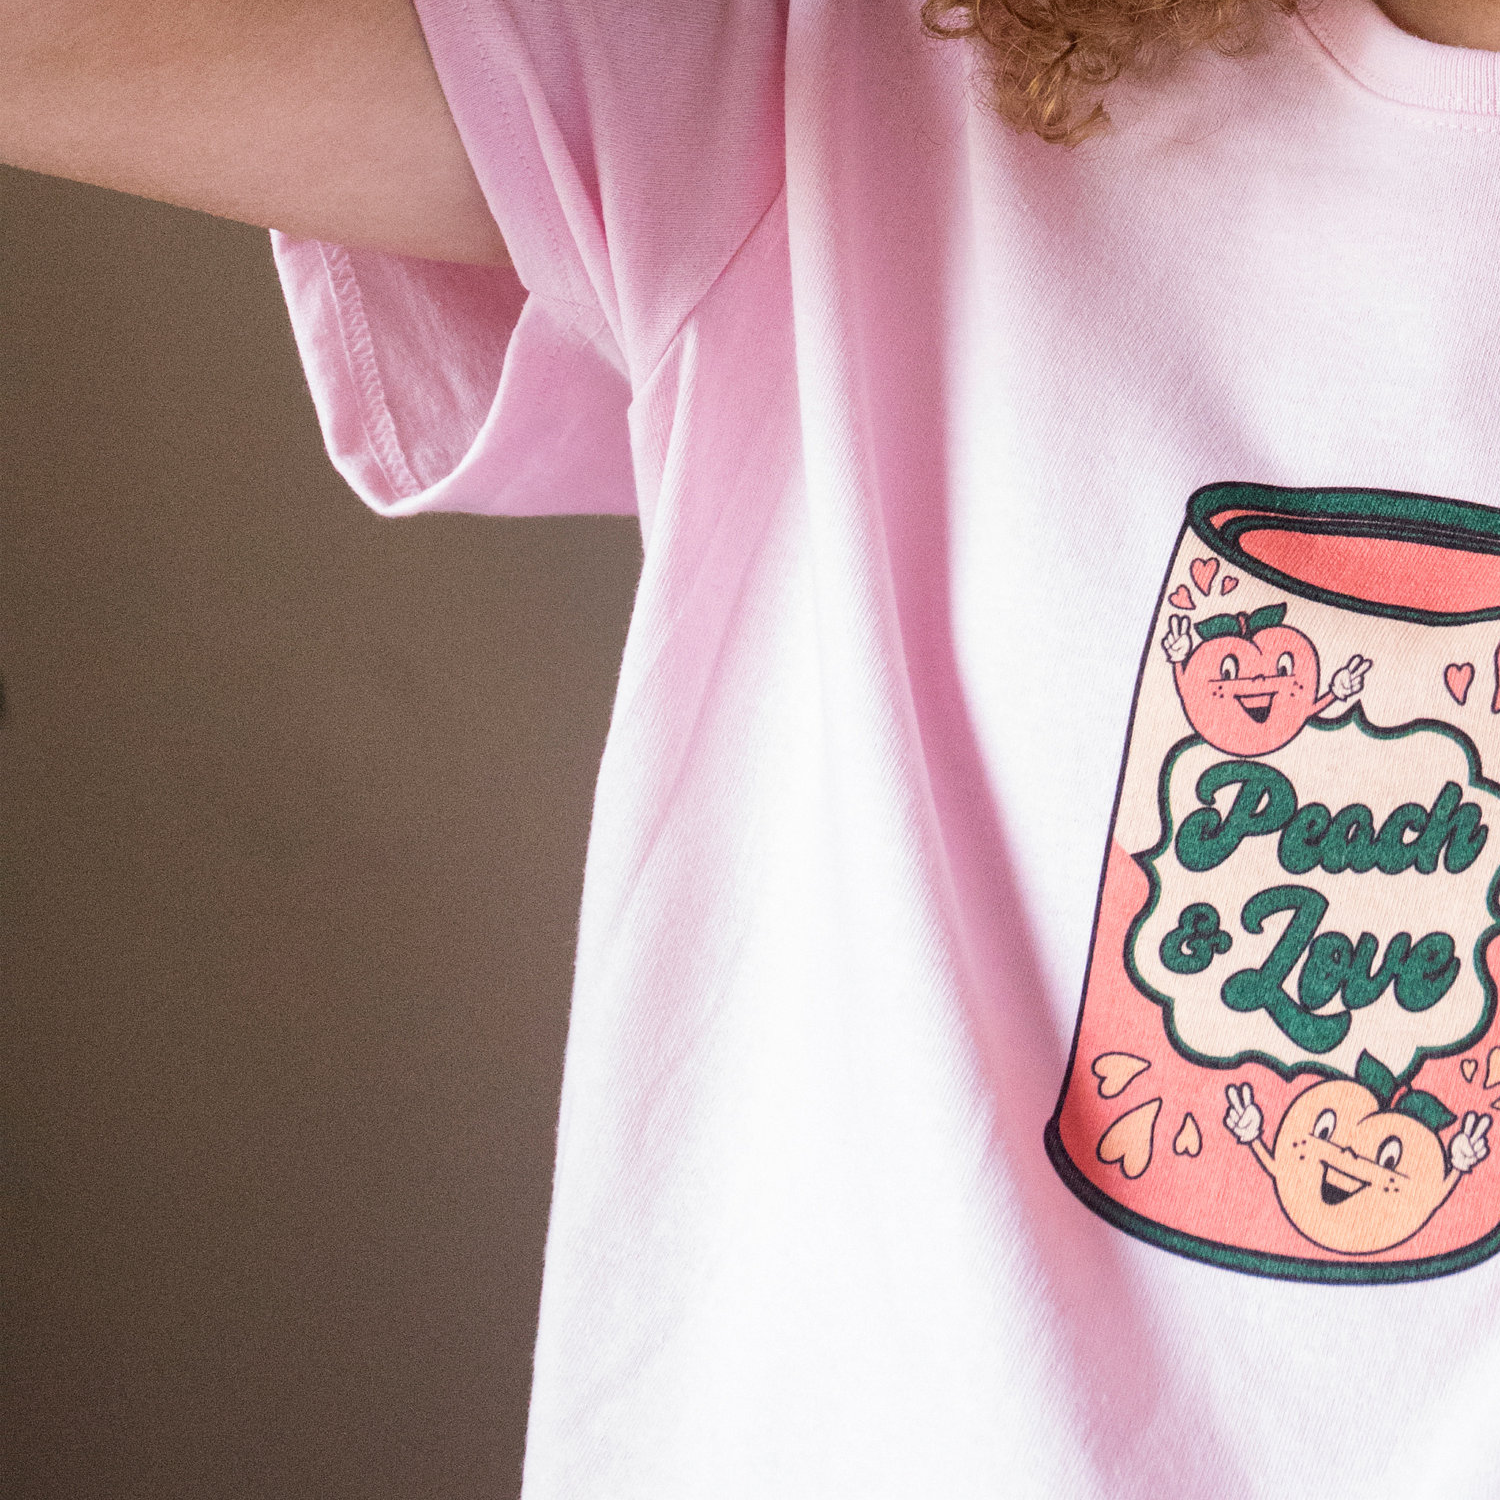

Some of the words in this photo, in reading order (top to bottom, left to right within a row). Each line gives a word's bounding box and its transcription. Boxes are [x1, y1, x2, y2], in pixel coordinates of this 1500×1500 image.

[1175, 760, 1488, 874] Peach
[1159, 902, 1233, 974] &
[1221, 884, 1460, 1053] Love
